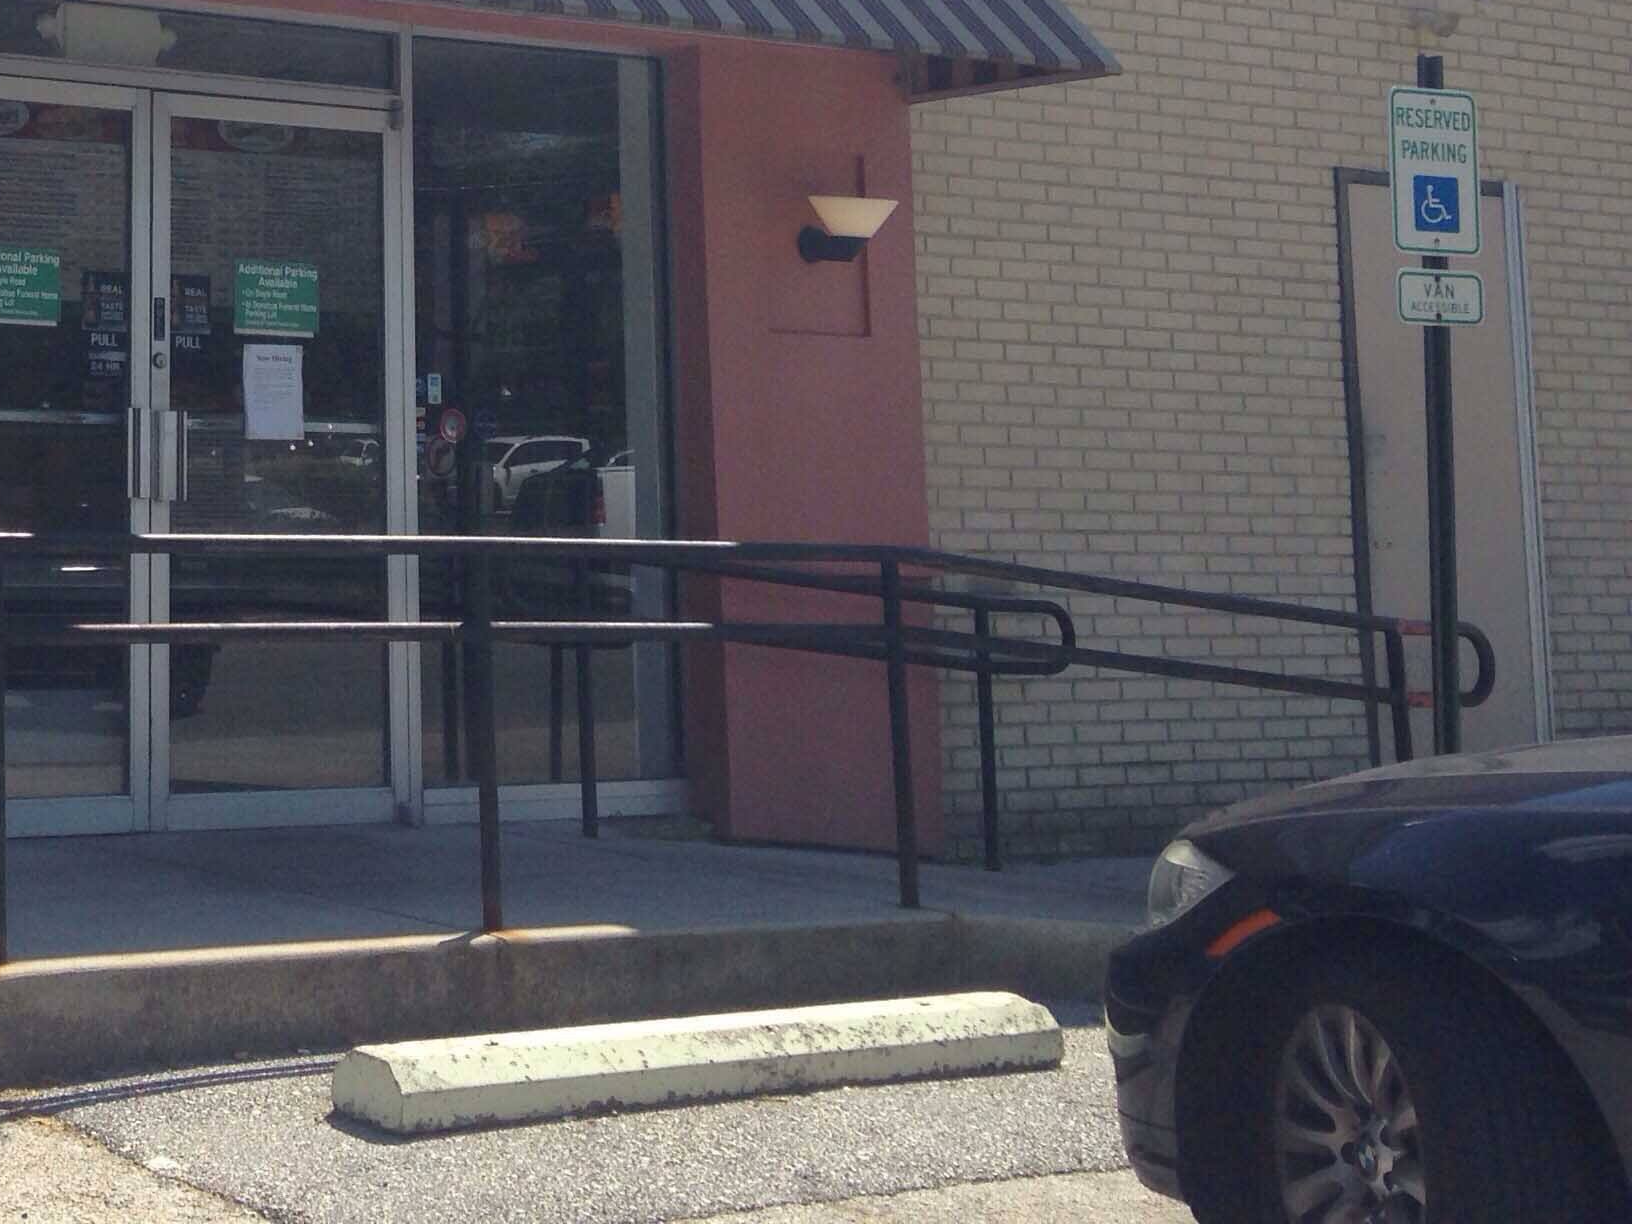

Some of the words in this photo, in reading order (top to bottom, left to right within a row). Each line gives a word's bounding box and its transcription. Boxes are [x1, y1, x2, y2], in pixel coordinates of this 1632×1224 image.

[1395, 106, 1471, 132] RESERVED
[1402, 139, 1468, 164] PARKING
[1424, 283, 1456, 301] VAN
[91, 333, 118, 347] PULL
[175, 335, 200, 349] PULL
